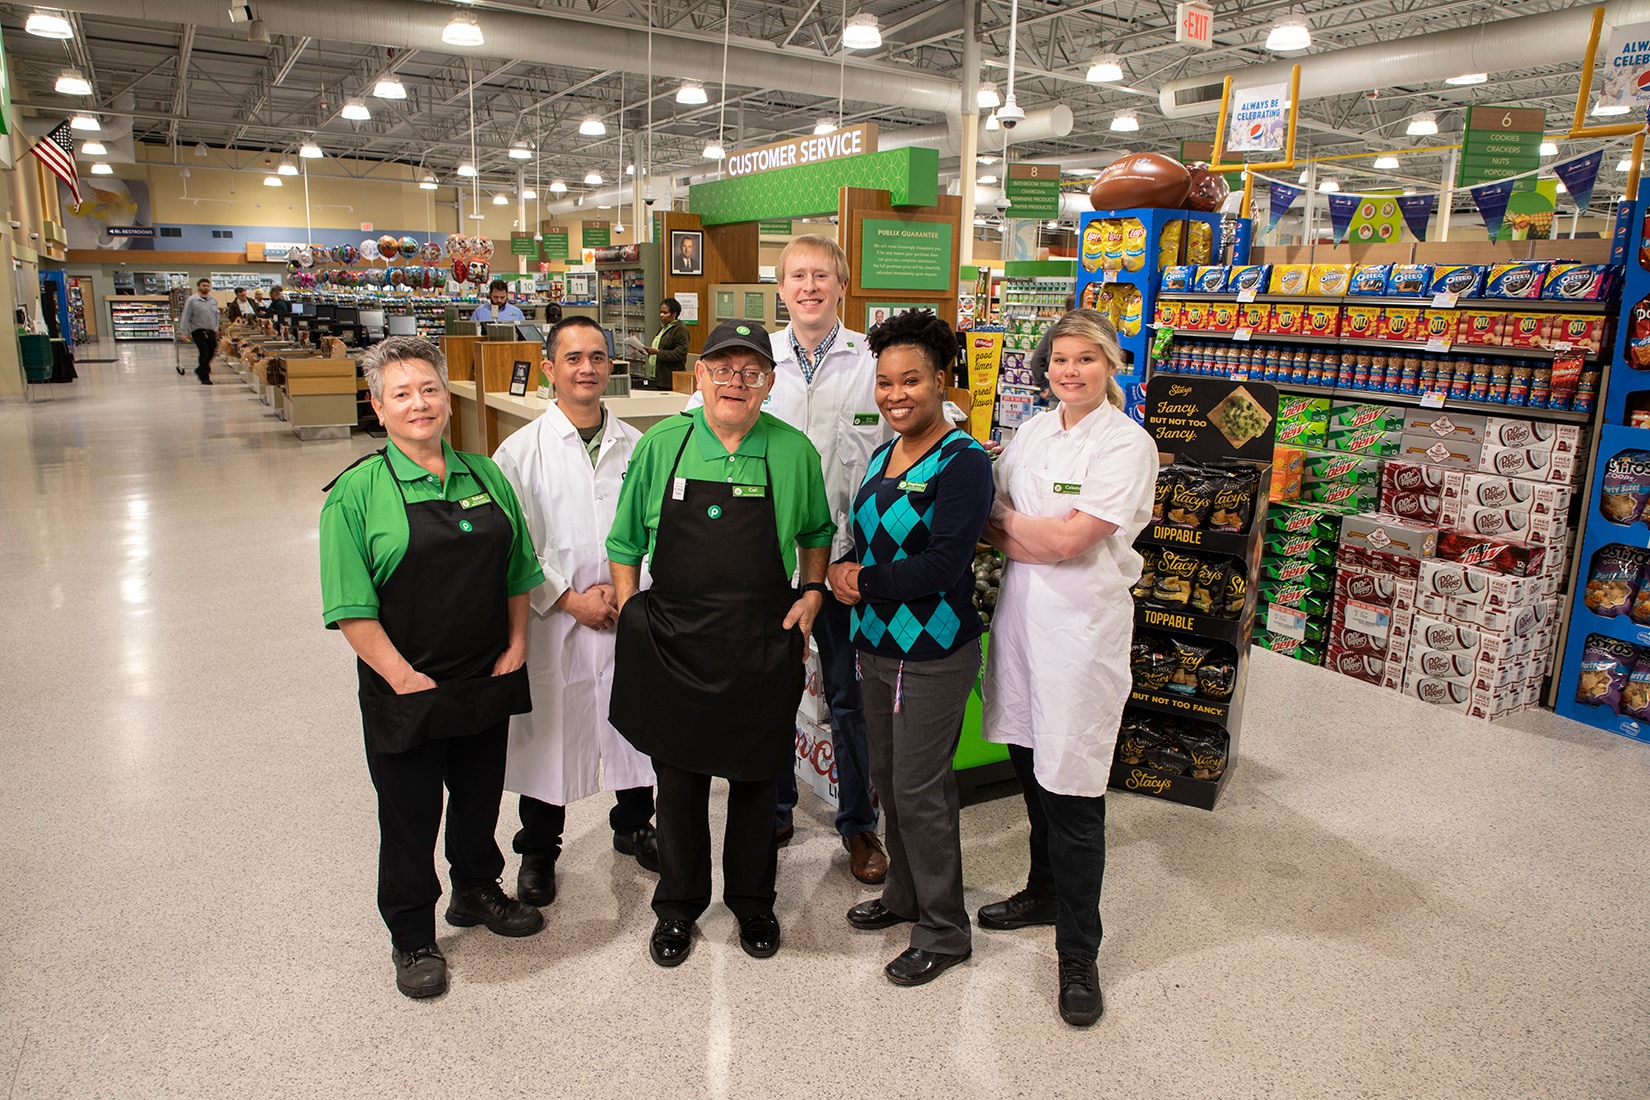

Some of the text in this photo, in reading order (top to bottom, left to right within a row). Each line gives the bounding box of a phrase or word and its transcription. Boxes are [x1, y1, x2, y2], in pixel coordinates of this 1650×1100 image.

[1188, 12, 1209, 41] EXIT
[1242, 99, 1279, 111] ALWAYS BE
[1237, 109, 1280, 121] CELEBRATING
[1501, 112, 1512, 127] 6
[728, 129, 862, 176] CUSTOMER SERVICE
[1030, 166, 1038, 177] 8
[1282, 274, 1301, 282] OREO
[1320, 274, 1342, 283] OREO
[1356, 274, 1383, 282] OREO
[1394, 272, 1423, 282] OREO
[1446, 275, 1472, 284] OREO
[1503, 274, 1530, 282] OREO
[1561, 274, 1590, 283] OREO
[452, 283, 458, 291] 8
[524, 282, 533, 291] 10
[575, 282, 583, 291] 11
[1279, 313, 1293, 325] RITZ
[1313, 314, 1327, 326] RITZ
[1352, 316, 1368, 328] RITZ
[1390, 318, 1406, 332] RITZ
[1474, 317, 1490, 329] RITZ
[1520, 319, 1537, 330] RITZ
[1429, 319, 1446, 333] RITZ
[1568, 321, 1586, 333] RITZ
[976, 350, 993, 361] good
[974, 361, 993, 370] times
[974, 386, 992, 399] great
[1168, 384, 1192, 396] Stacy's
[972, 398, 993, 410] flavor
[1506, 429, 1527, 441] Pepper
[1501, 456, 1522, 469] Pepper
[1173, 484, 1211, 511] Stacy's
[1214, 489, 1249, 506] tacy's
[1483, 490, 1505, 501] Pepper
[1479, 516, 1501, 529] Pepper
[1154, 526, 1203, 545] DIPPABLE
[1438, 578, 1460, 589] Pepper
[1145, 610, 1195, 630] TOPPABLE
[1431, 632, 1453, 644] Pepper
[1427, 660, 1448, 670] Pepper
[1422, 687, 1444, 697] Pepper
[1132, 692, 1150, 701] BUT
[1152, 696, 1170, 705] NOT
[1172, 699, 1191, 710] TOO
[1125, 769, 1172, 794] Stacy's
